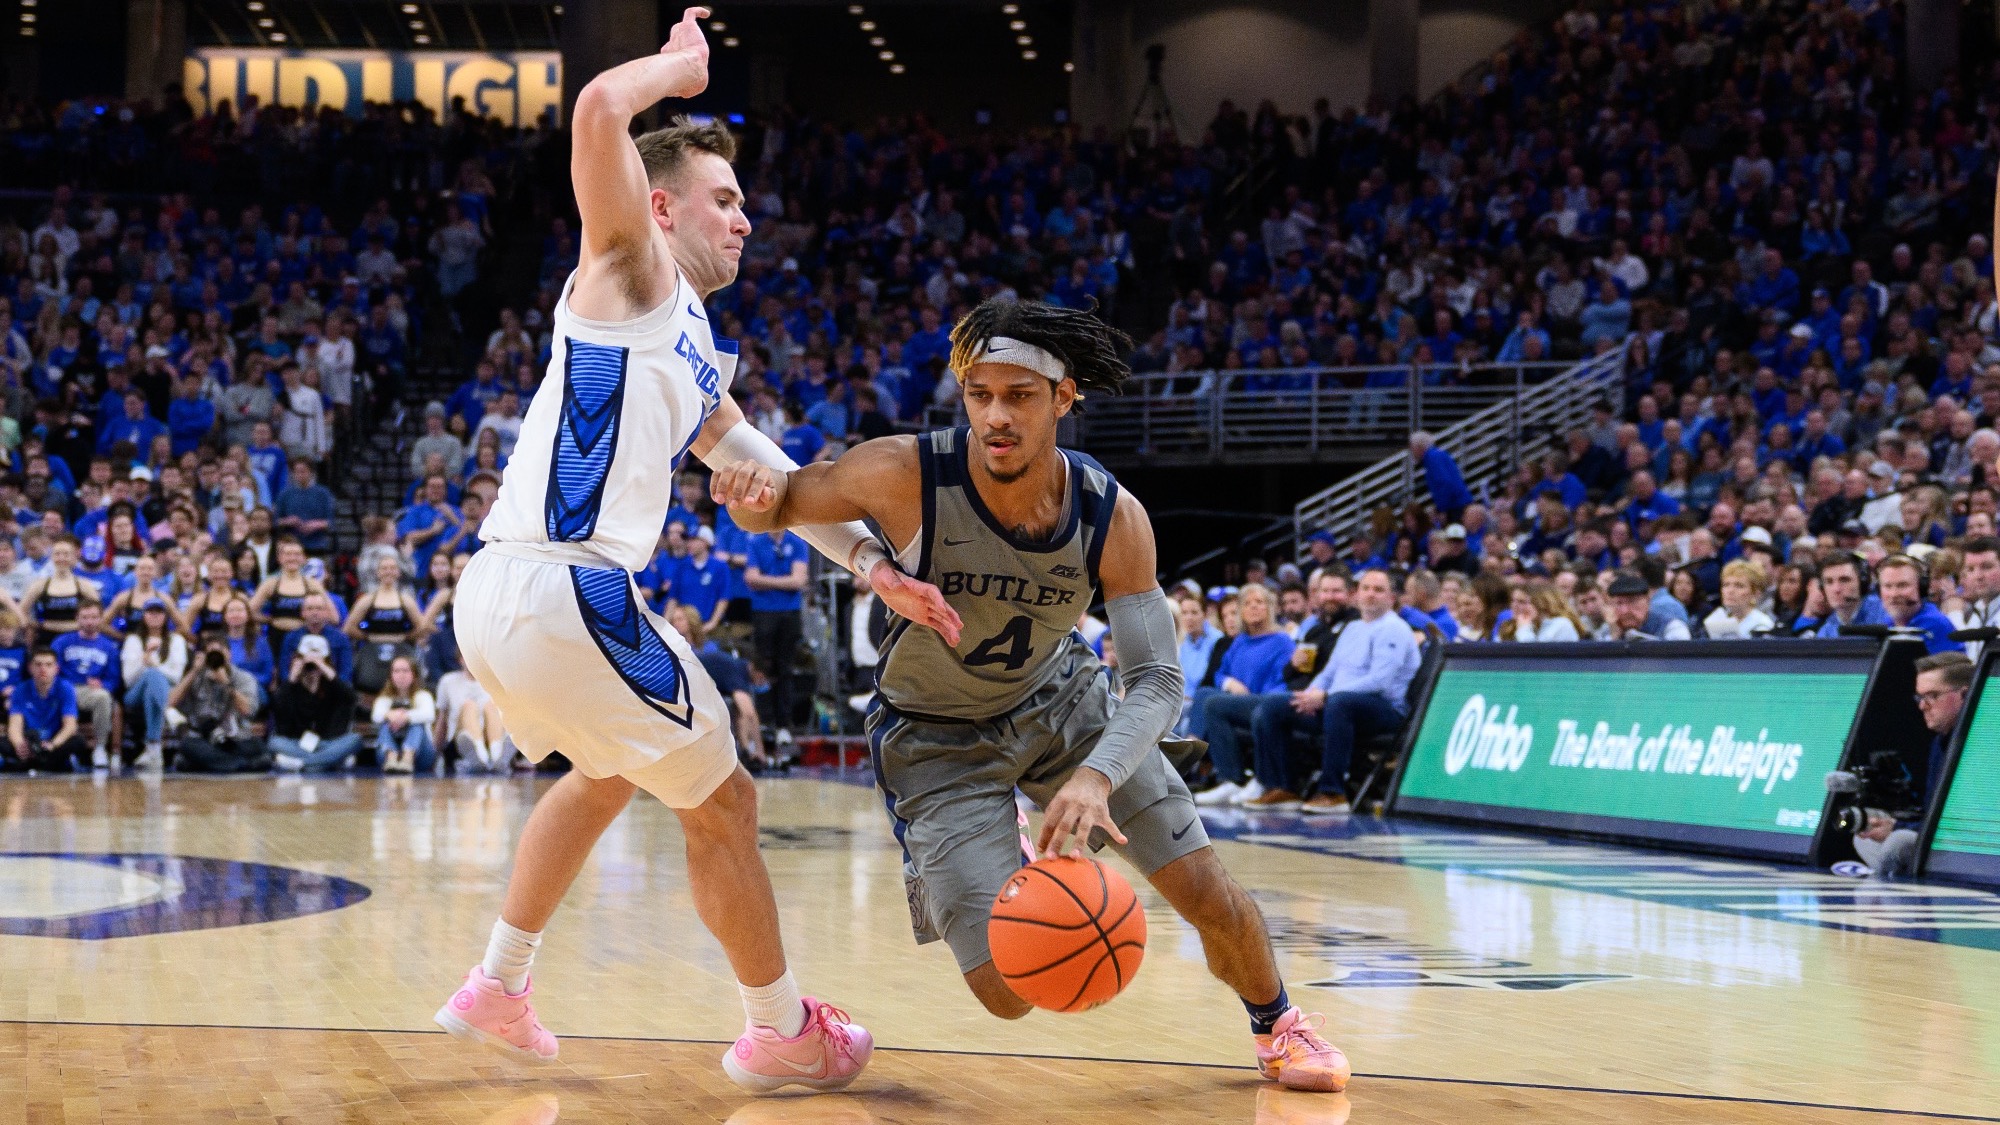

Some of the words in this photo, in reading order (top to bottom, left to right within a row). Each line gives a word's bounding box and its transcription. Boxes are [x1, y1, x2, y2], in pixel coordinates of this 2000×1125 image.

[941, 571, 1076, 607] BUTLER
[963, 615, 1035, 671] 4
[1550, 719, 1588, 767] The
[1583, 720, 1643, 771] Bank
[1637, 723, 1674, 773] of
[1663, 723, 1705, 775] the
[1700, 725, 1803, 795] Bluejays
